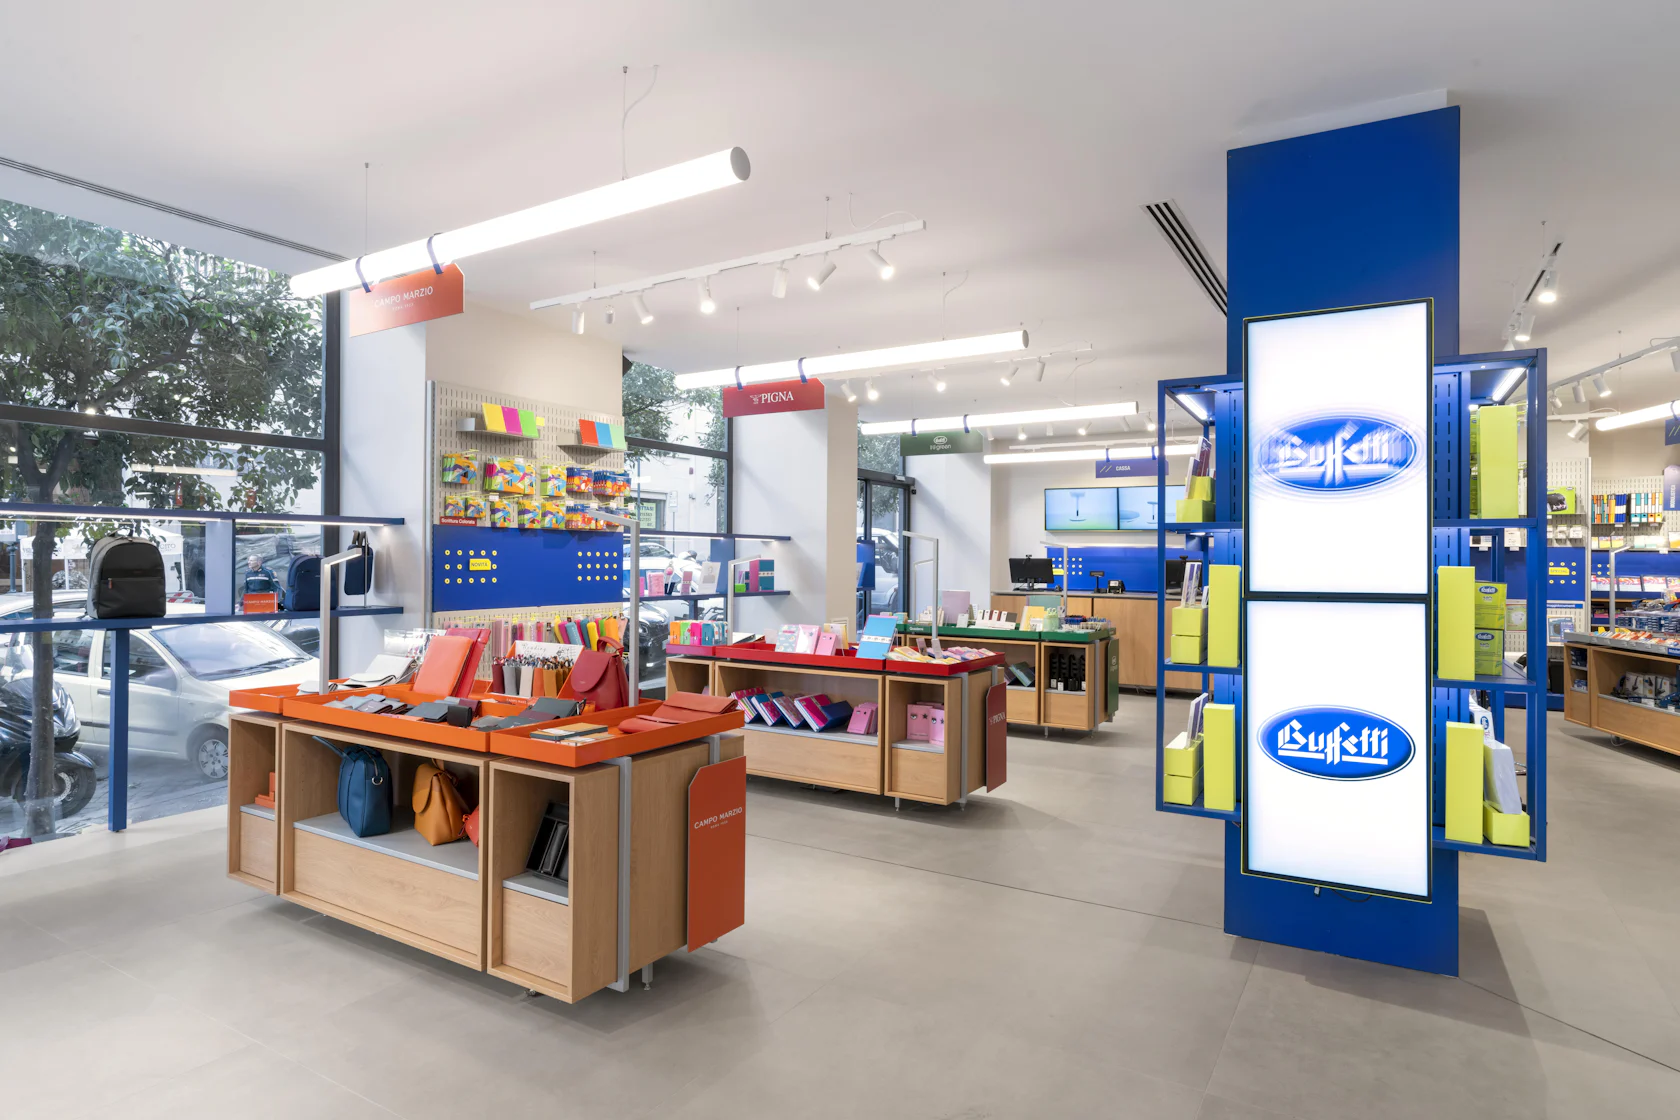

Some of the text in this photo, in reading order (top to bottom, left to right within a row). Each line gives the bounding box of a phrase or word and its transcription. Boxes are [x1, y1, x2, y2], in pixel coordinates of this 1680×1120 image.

[374, 286, 433, 307] CAMPO MARZIO
[761, 391, 794, 404] PIGNA
[1277, 718, 1389, 766] Buffetti
[694, 806, 743, 829] CAMPO MARZIO
